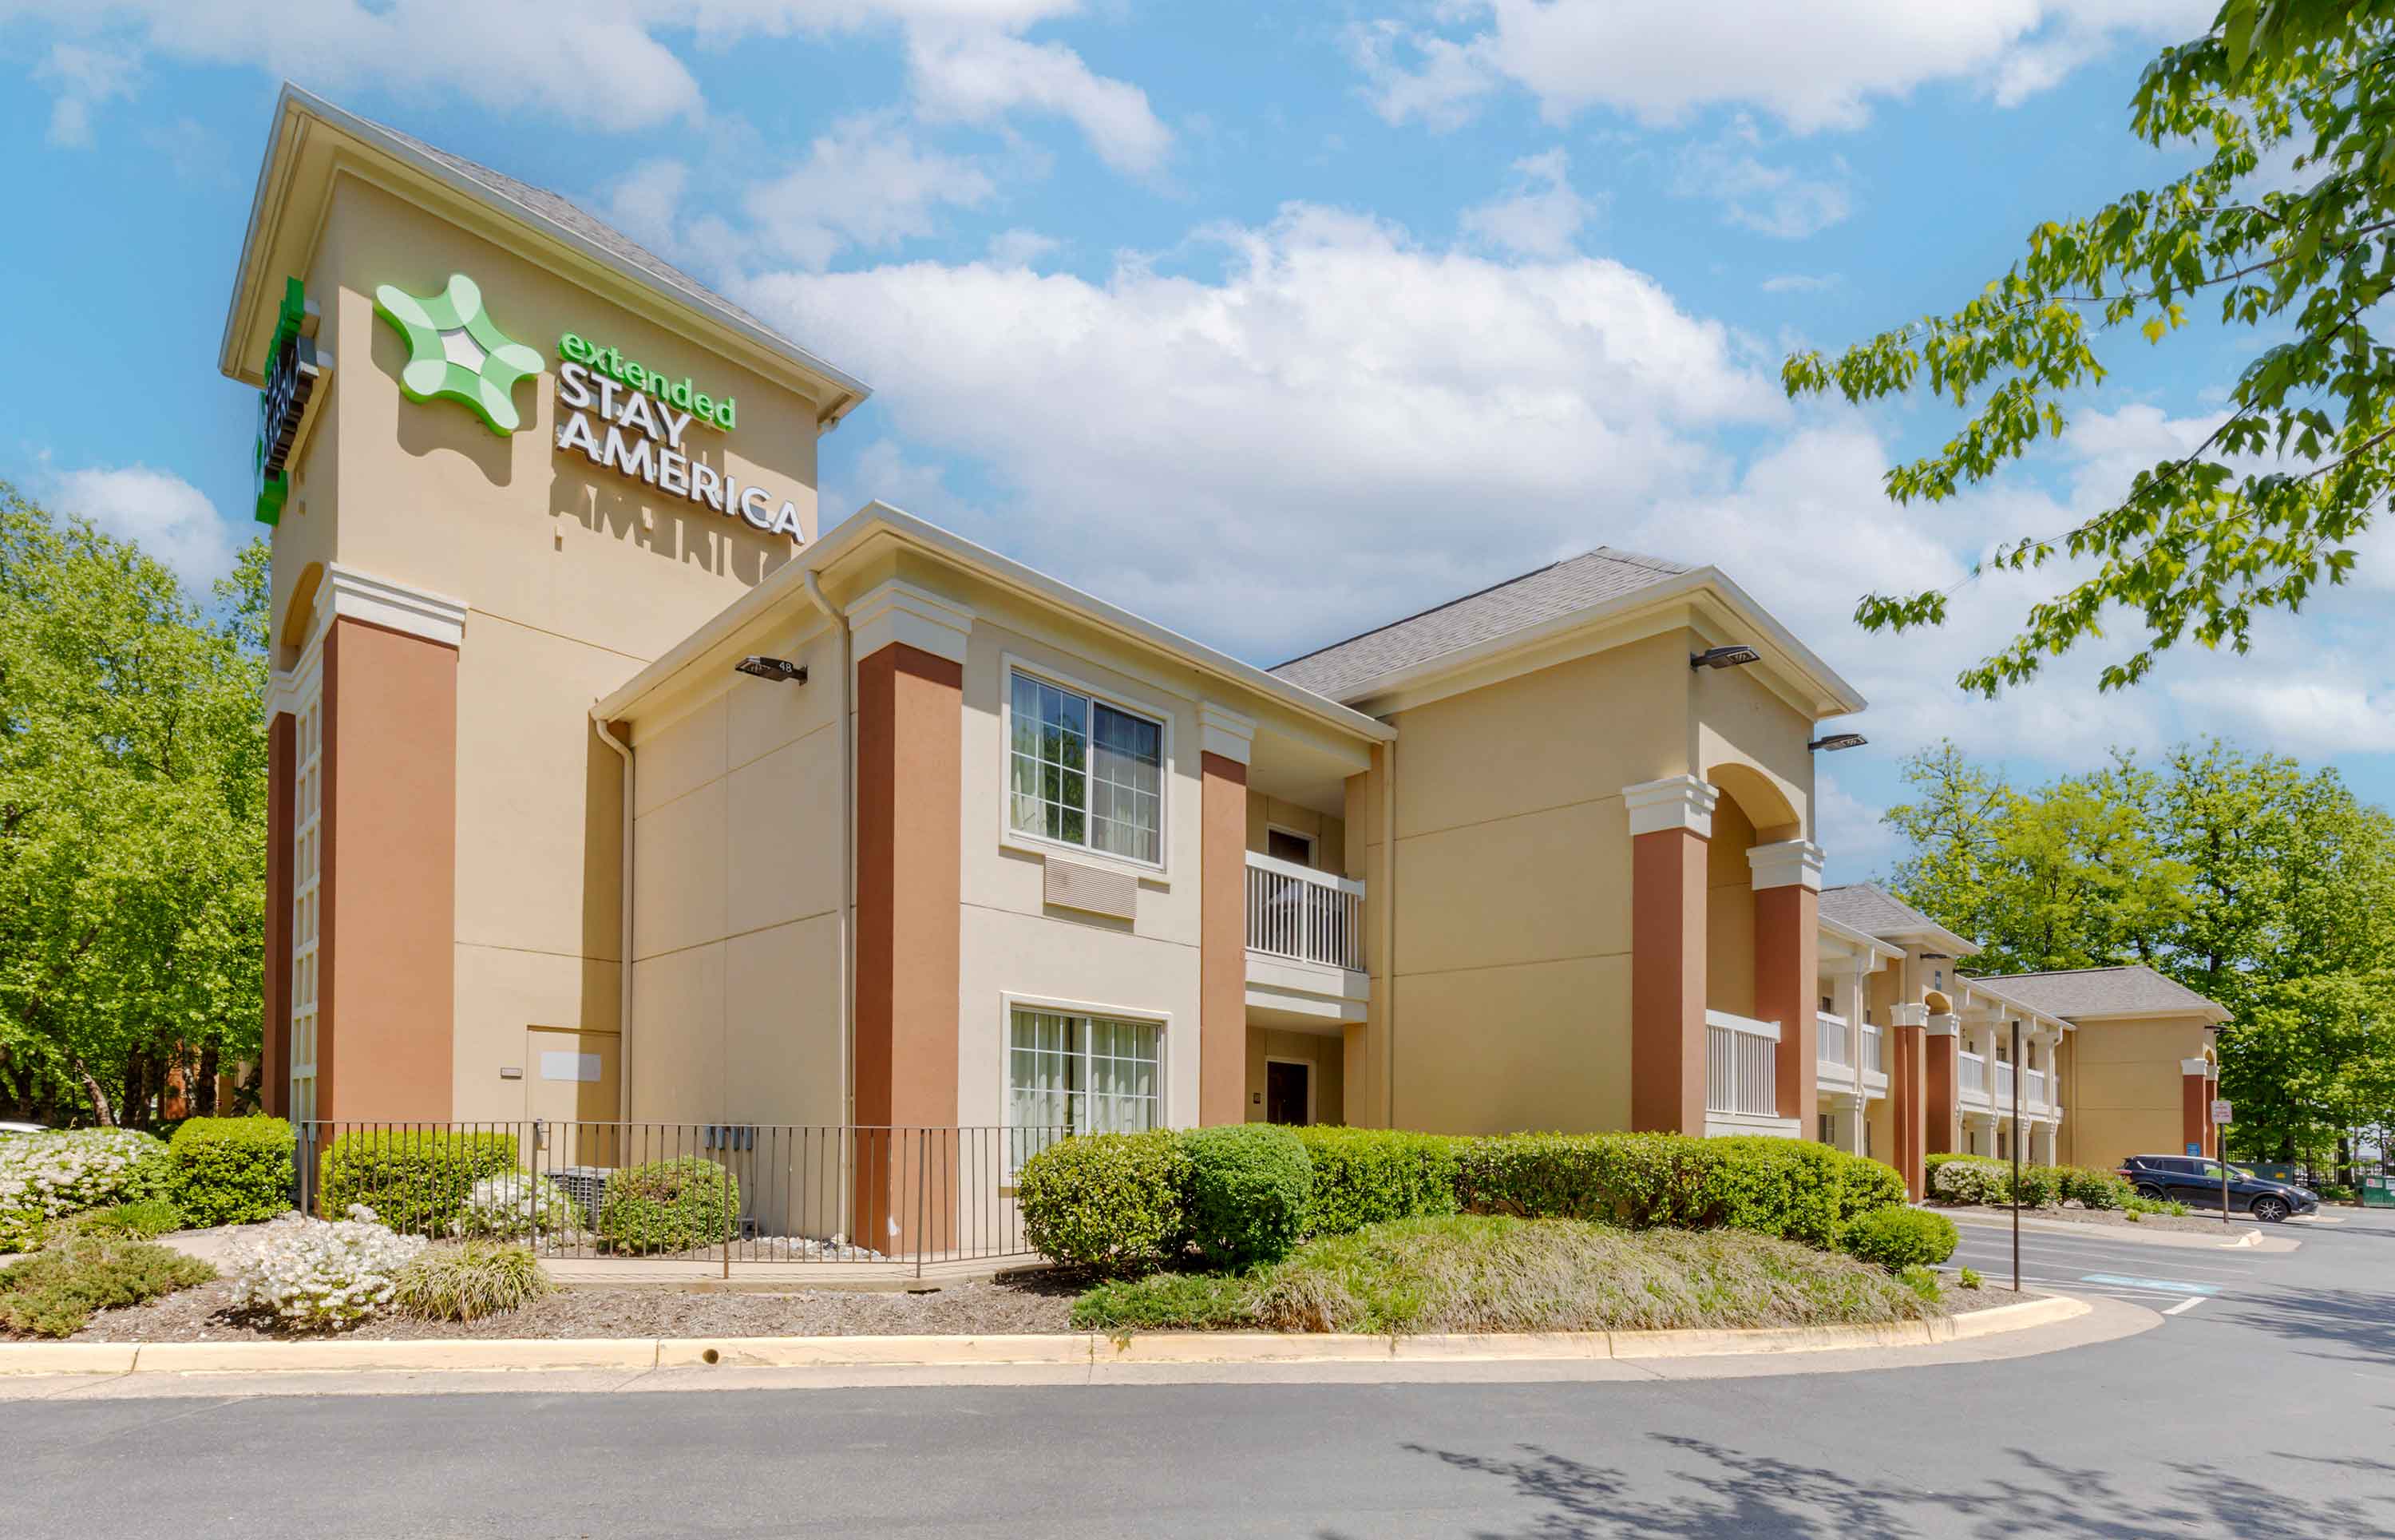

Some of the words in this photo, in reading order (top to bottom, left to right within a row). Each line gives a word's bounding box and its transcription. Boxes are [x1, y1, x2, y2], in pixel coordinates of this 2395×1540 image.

[559, 332, 736, 431] extended
[560, 362, 691, 448] STAY
[558, 411, 805, 545] AMERICA
